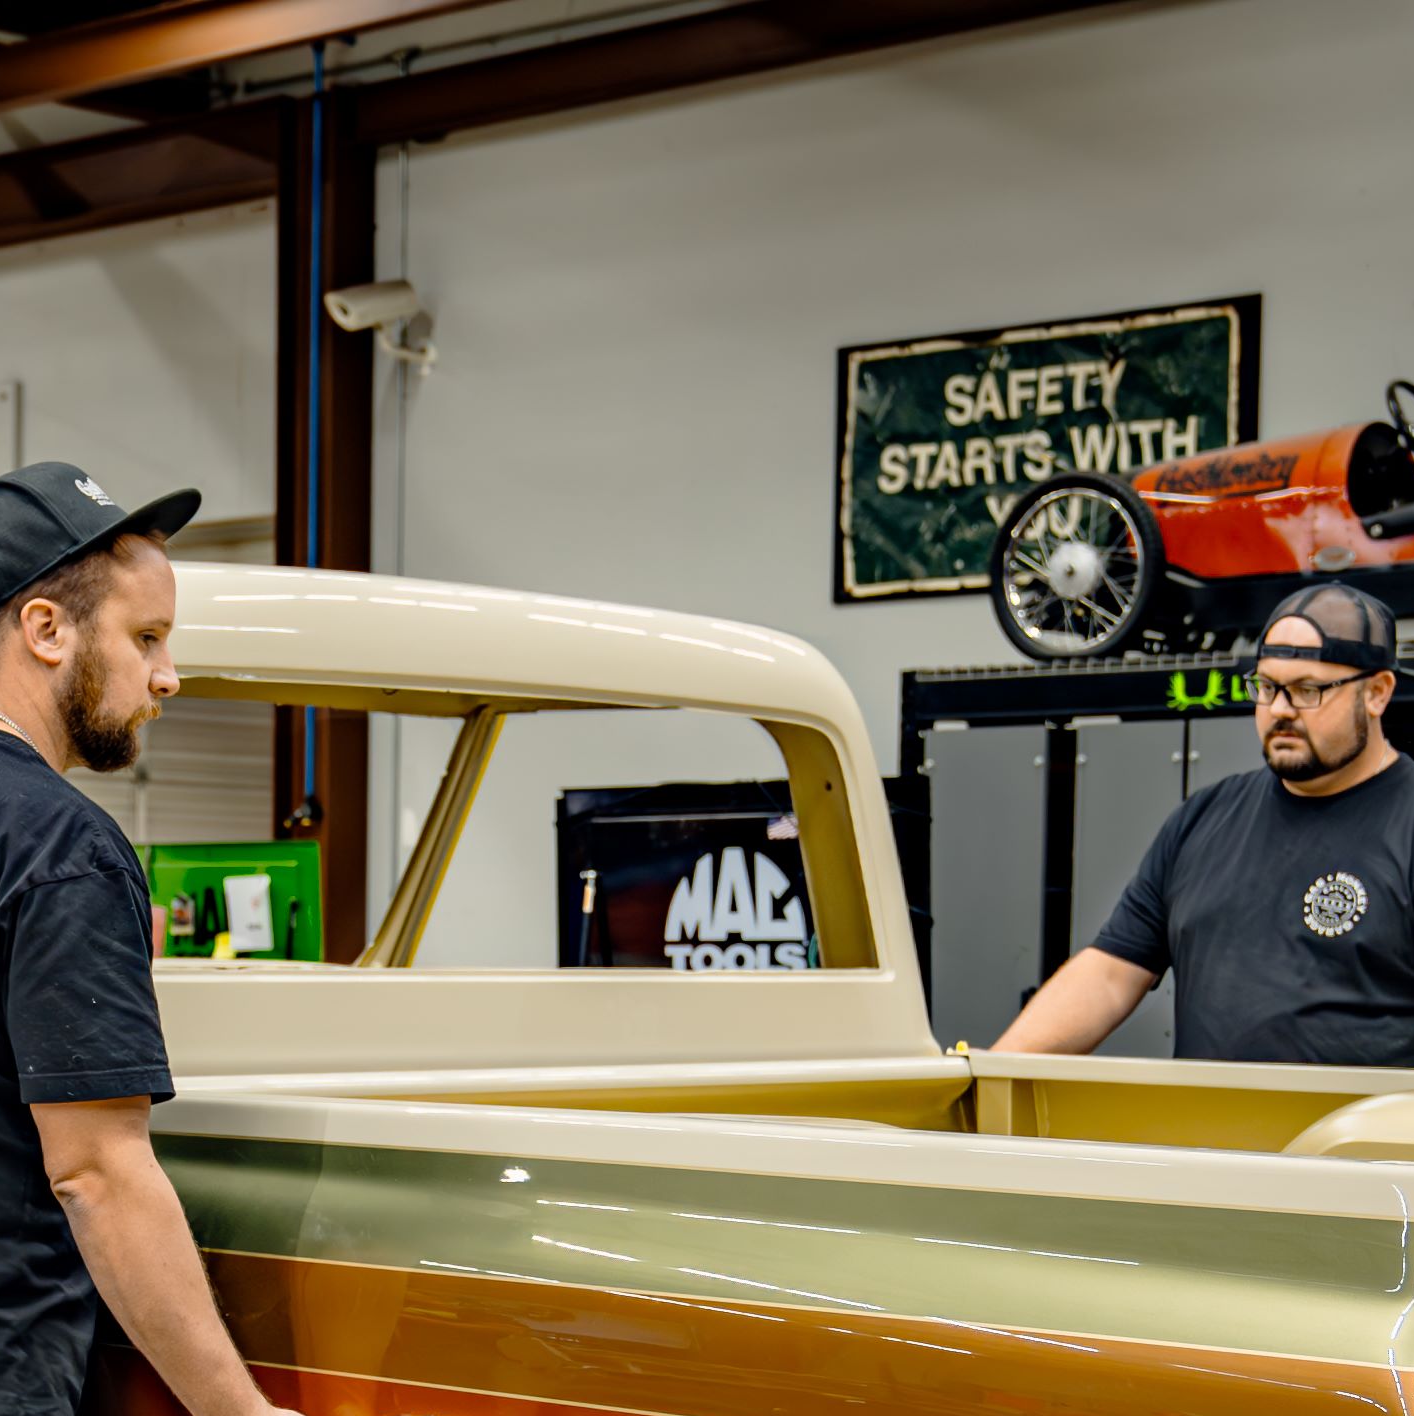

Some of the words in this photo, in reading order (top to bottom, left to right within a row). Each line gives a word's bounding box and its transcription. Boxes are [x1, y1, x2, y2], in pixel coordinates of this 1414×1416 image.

[943, 358, 1126, 428] SAFETY
[876, 431, 1053, 495] STARTS
[1069, 414, 1199, 474] WITH
[663, 847, 808, 942] MAC
[663, 943, 807, 971] TOOLS
